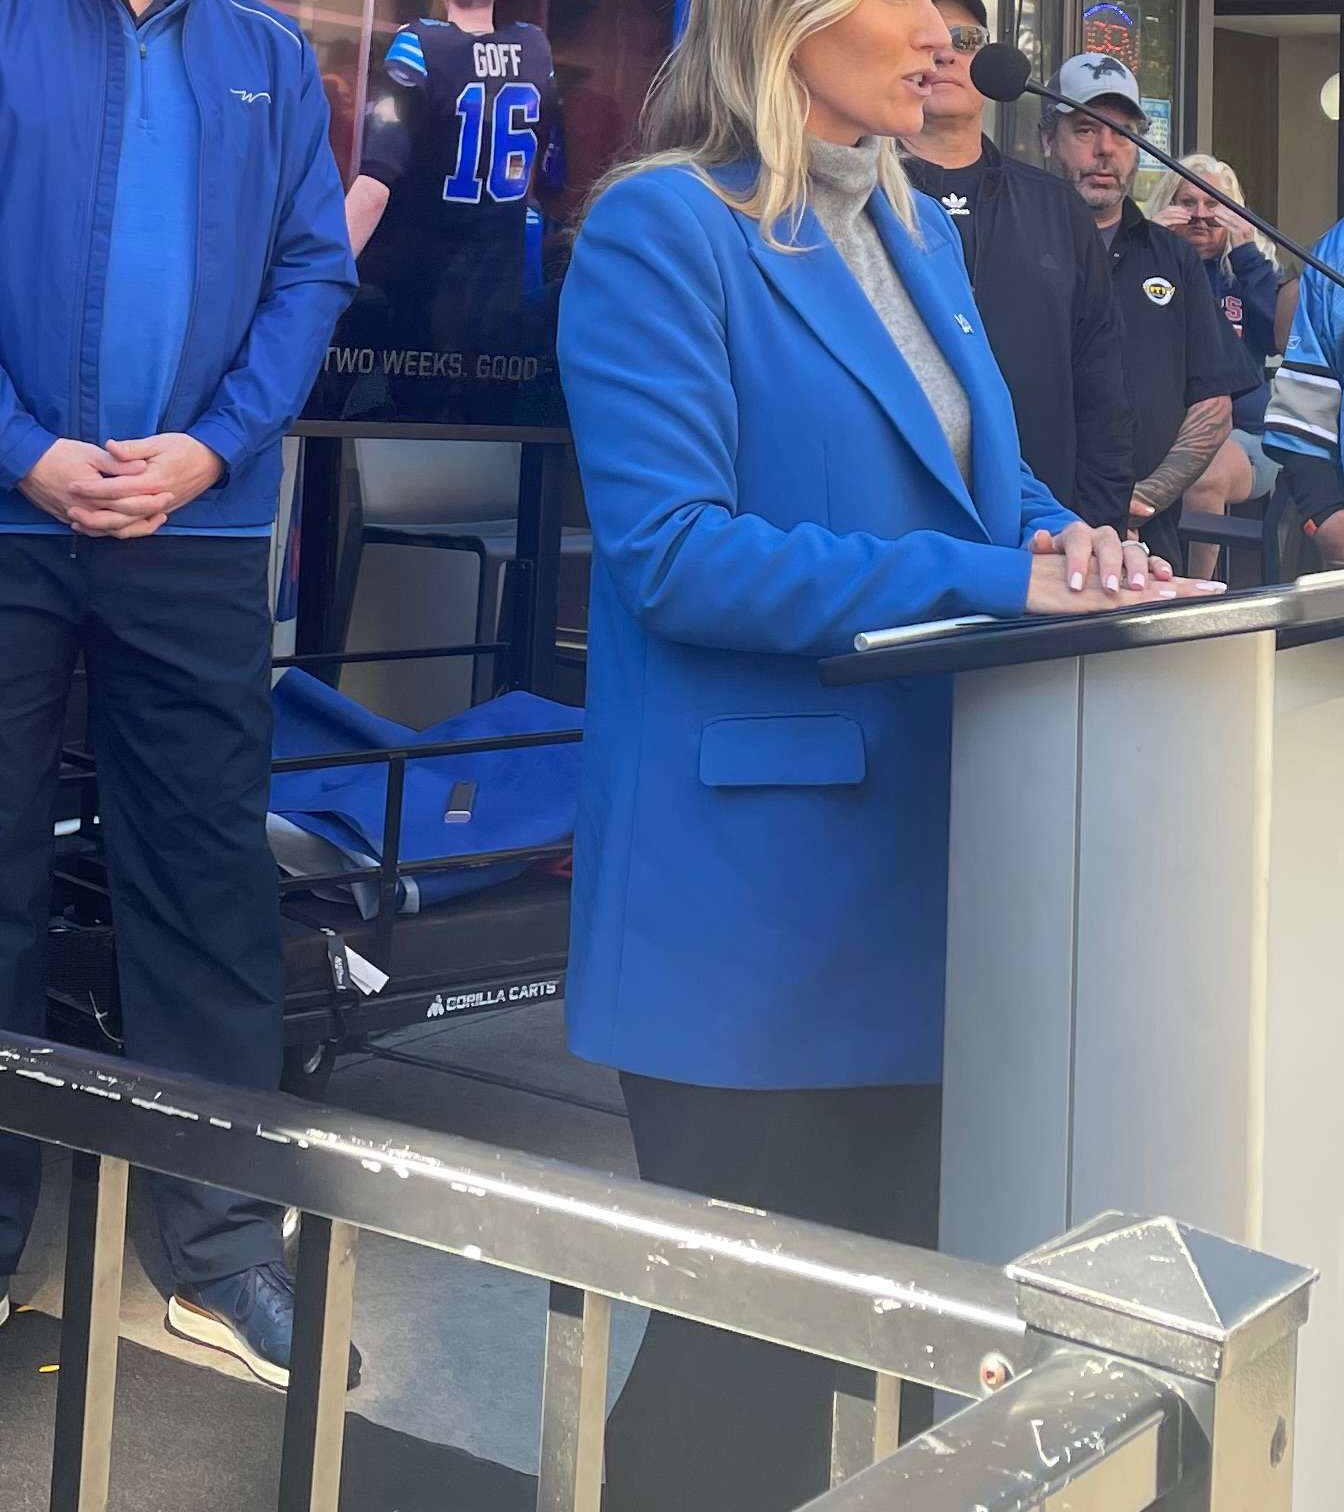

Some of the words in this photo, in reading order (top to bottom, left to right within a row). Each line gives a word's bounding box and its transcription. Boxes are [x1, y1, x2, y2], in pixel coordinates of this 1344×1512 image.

[472, 42, 523, 79] GOFF
[442, 81, 541, 205] 16
[324, 346, 374, 374] TWO
[382, 349, 468, 378] WEEKS.
[475, 354, 538, 381] GOOD
[445, 988, 506, 1012] GORILLA
[508, 980, 557, 1001] CARTS
